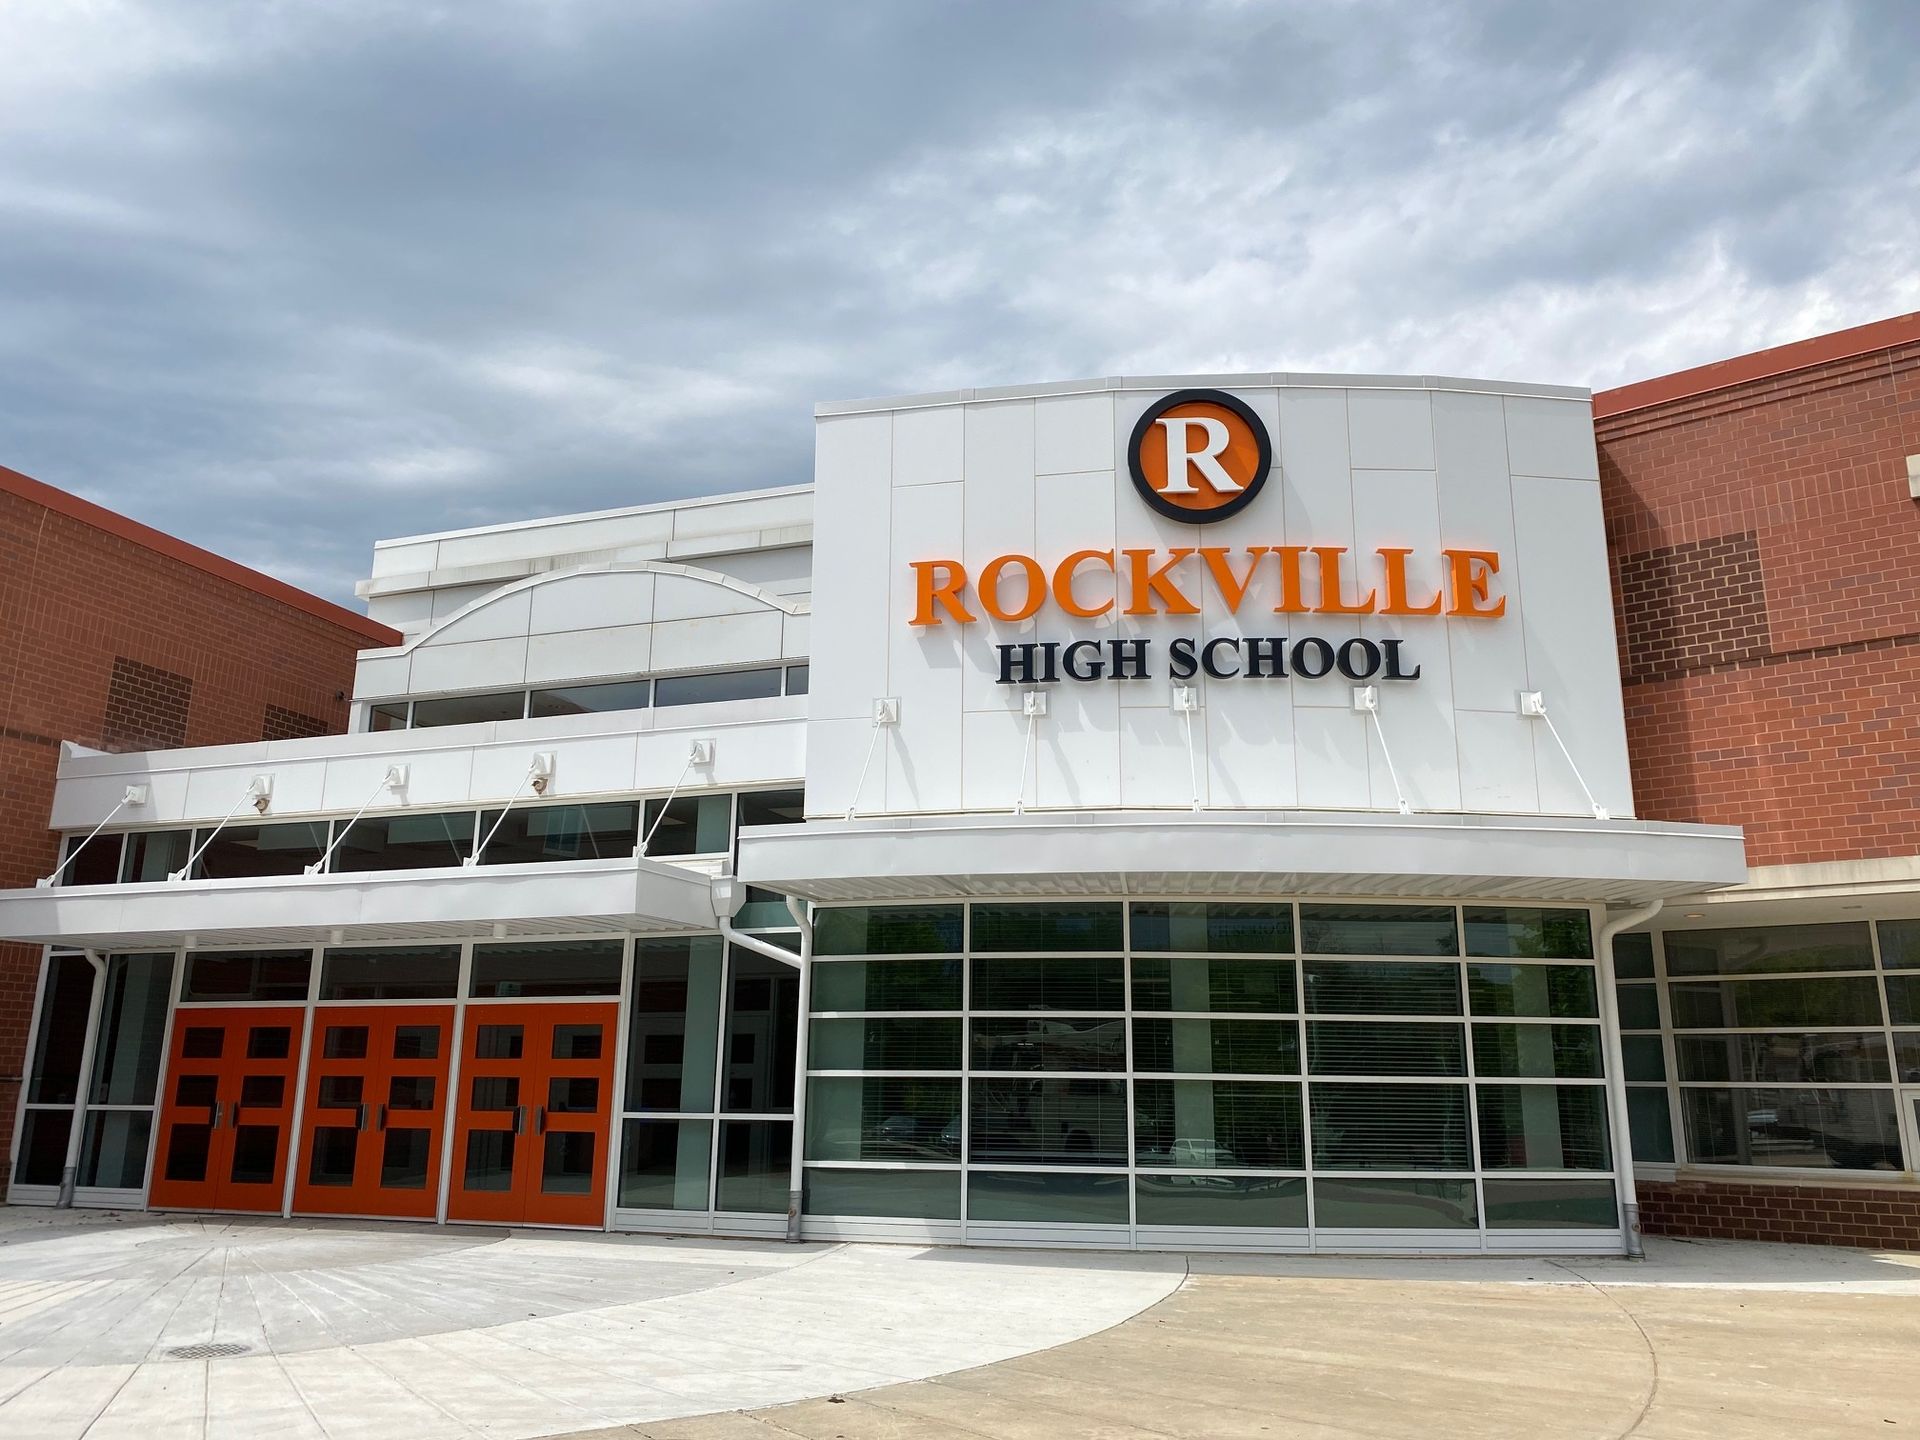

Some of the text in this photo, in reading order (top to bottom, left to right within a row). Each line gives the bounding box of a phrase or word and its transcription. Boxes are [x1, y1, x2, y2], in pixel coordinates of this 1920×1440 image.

[1155, 417, 1244, 493] R
[908, 546, 1506, 626] ROCKVILLE
[995, 636, 1421, 685] HIGH SCHOOL
